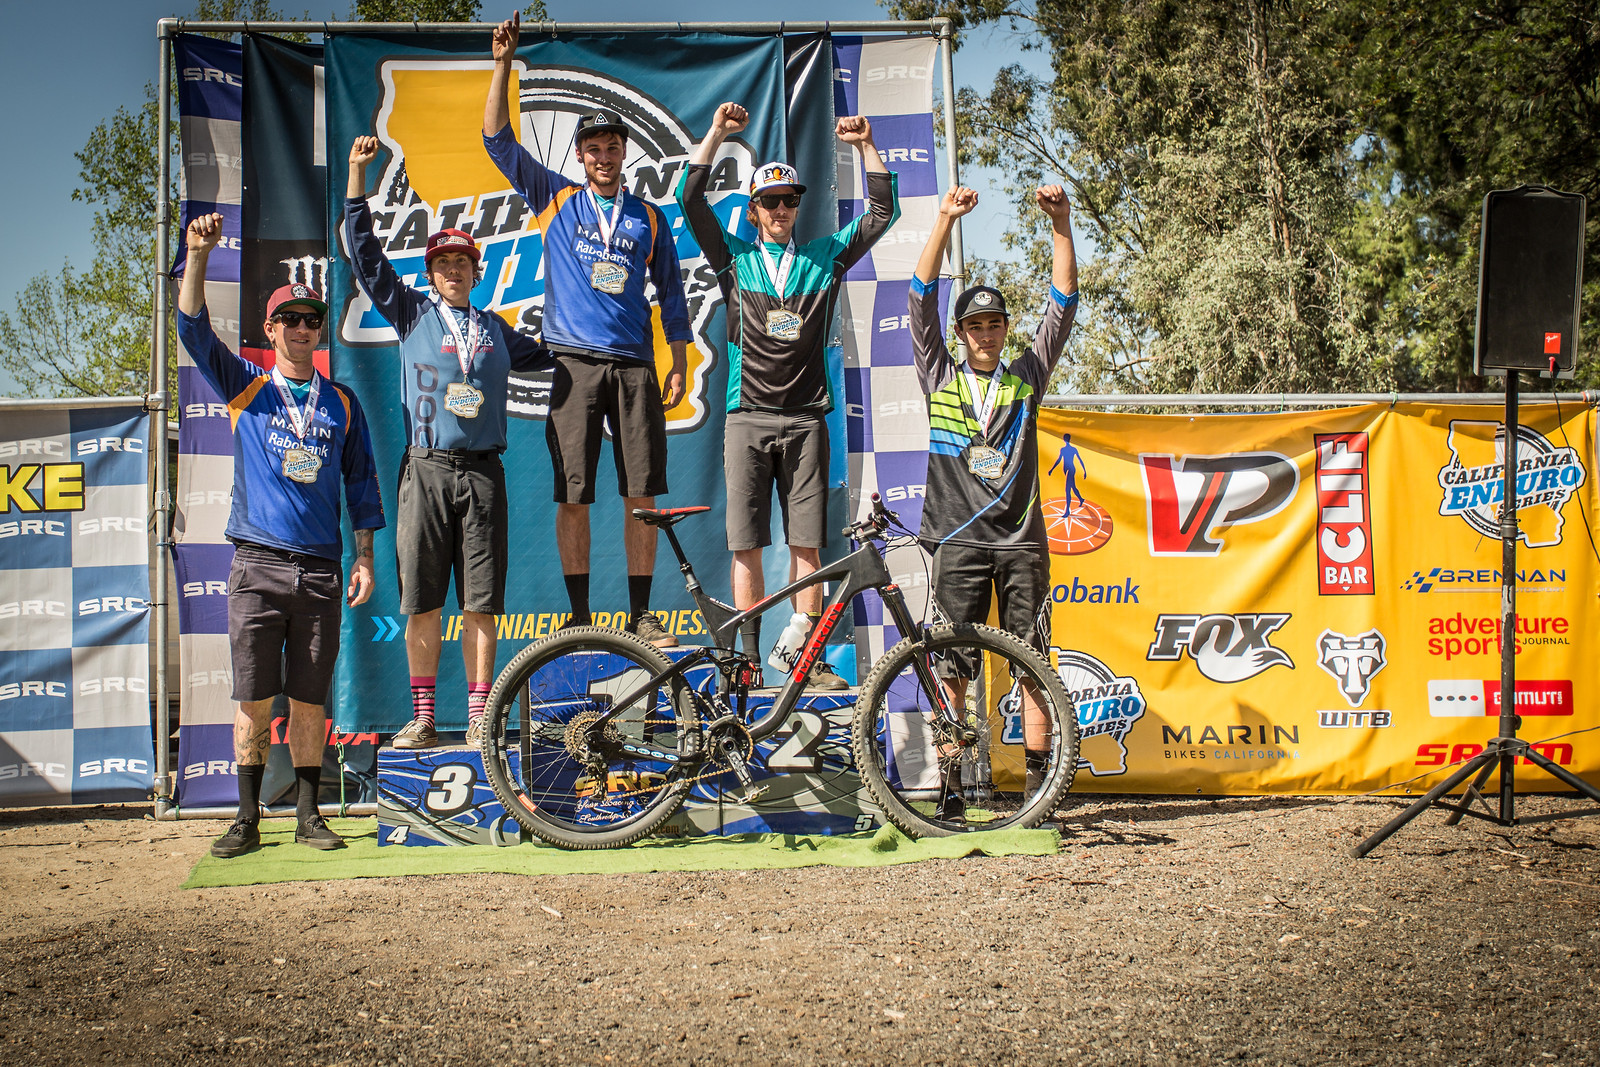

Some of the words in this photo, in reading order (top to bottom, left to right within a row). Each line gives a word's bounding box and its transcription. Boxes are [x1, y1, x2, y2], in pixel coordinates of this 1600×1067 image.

[866, 65, 928, 82] SRC
[764, 167, 792, 180] FOX
[577, 224, 634, 251] MAIN
[185, 403, 229, 418] SR
[880, 400, 926, 417] SR
[271, 416, 331, 439] MAIN
[0, 440, 64, 457] SRC
[77, 437, 143, 456] SRC
[1443, 453, 1572, 485] CALIFRNIA
[0, 462, 85, 513] KE
[886, 485, 926, 502] SR
[185, 491, 229, 506] SR
[1139, 453, 1300, 556] VP
[1321, 440, 1366, 563] CLIF
[0, 519, 65, 539] SRC
[79, 516, 143, 536] SRC
[1325, 566, 1367, 584] BAR
[183, 581, 228, 598] SR
[1052, 577, 1140, 604] obank
[0, 600, 65, 617] SRC
[79, 596, 149, 616] SRC
[1147, 613, 1295, 675] FOX
[1522, 637, 1570, 645] JOURNAL
[80, 676, 146, 694] SRC
[188, 671, 233, 688] SR
[0, 681, 66, 698] SRC
[1317, 709, 1392, 728] WTB
[766, 710, 826, 771] 2
[1163, 724, 1299, 745] MARIN
[1164, 750, 1206, 759] BIKES
[1214, 750, 1301, 759] CALIFORNIA
[1415, 743, 1574, 766] SRM
[0, 761, 65, 779] SRC
[79, 758, 148, 779] SRC
[425, 764, 475, 814] 3
[855, 813, 875, 832] 5
[385, 825, 409, 844] 4
